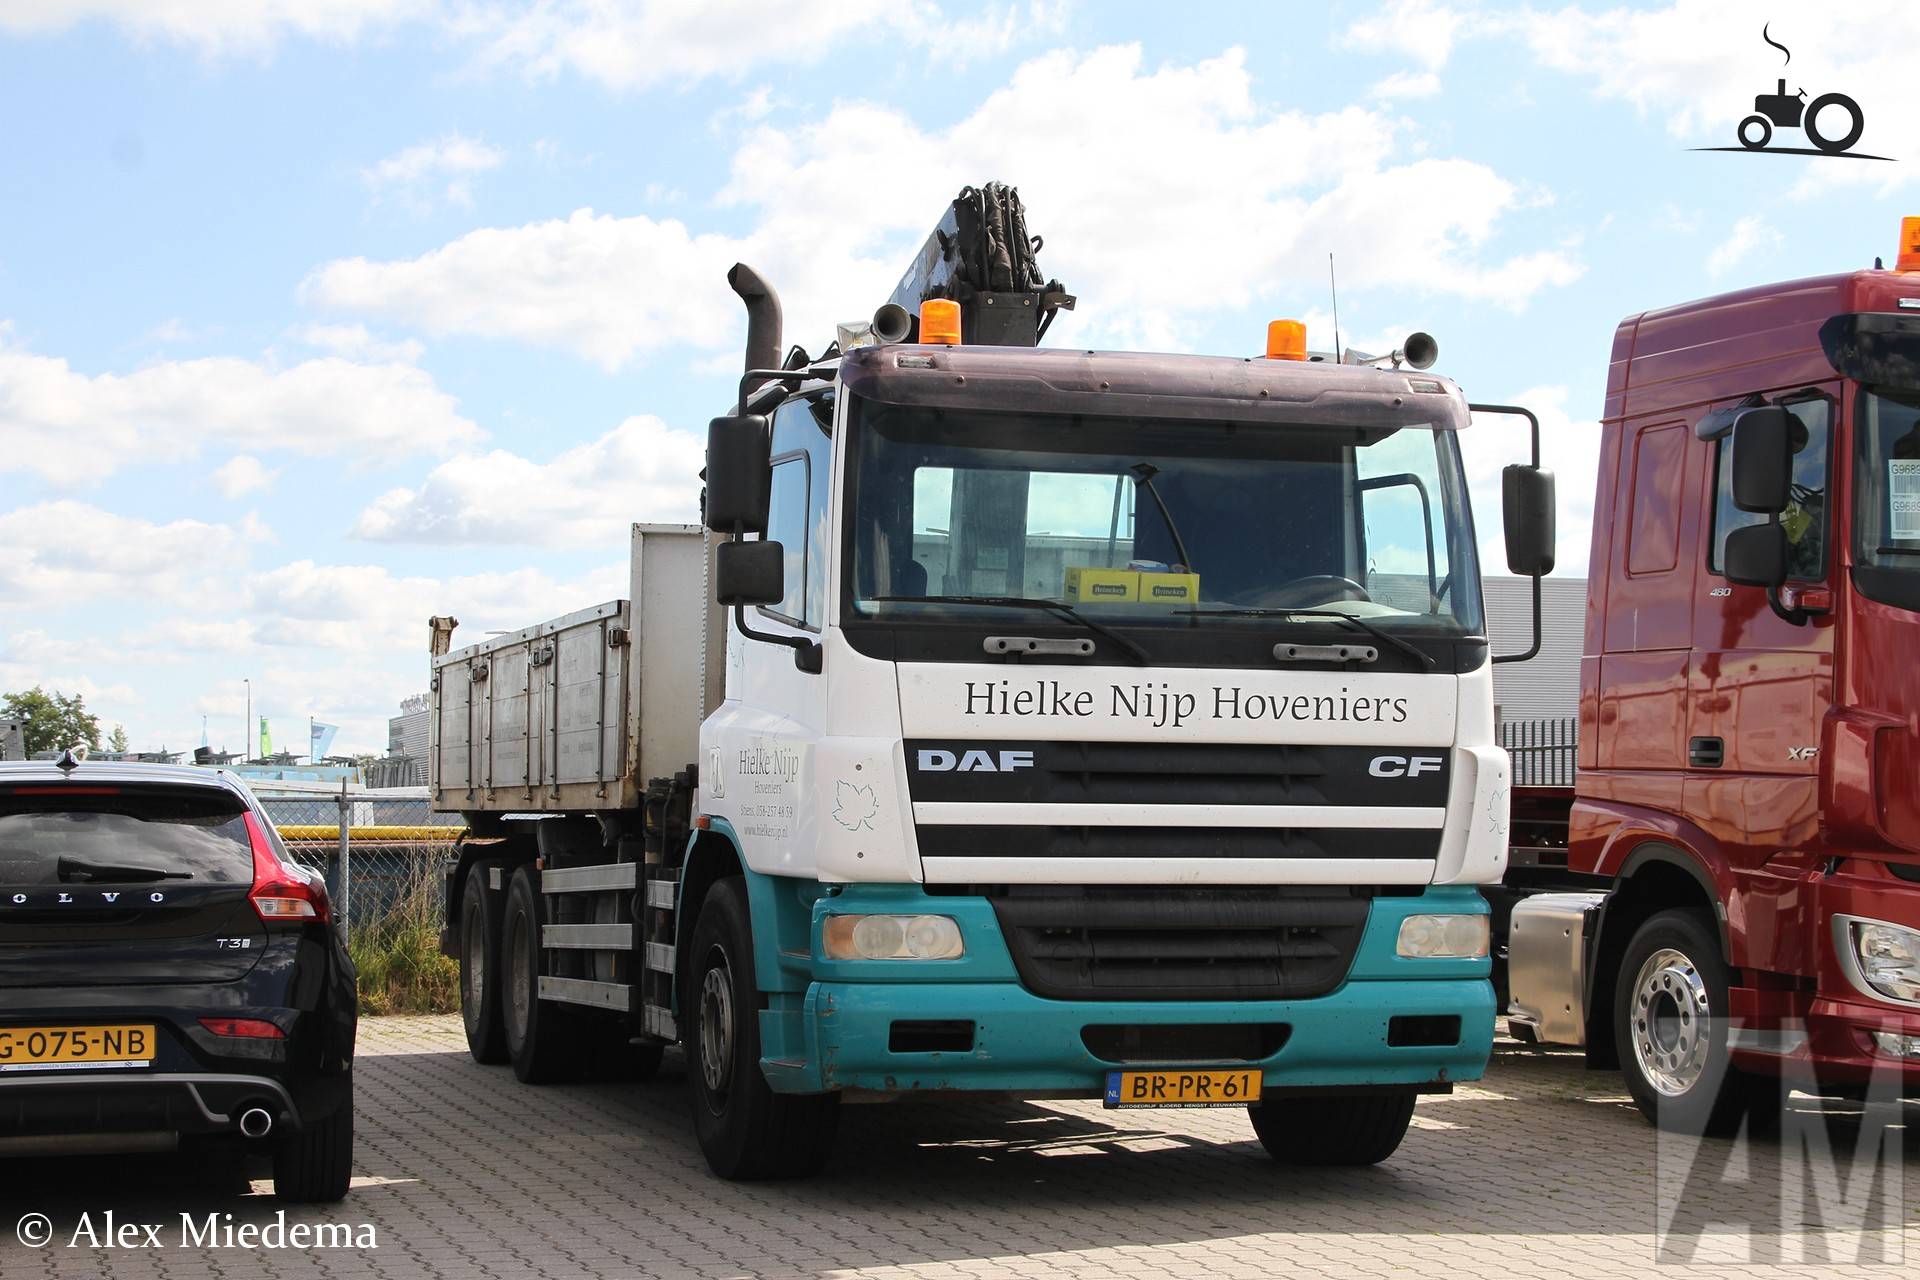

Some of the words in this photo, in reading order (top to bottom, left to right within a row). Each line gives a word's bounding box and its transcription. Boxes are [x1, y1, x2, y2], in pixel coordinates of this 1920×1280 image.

[964, 680, 1094, 717] Hielke
[1110, 682, 1197, 729] Nijp
[1212, 686, 1409, 724] Hoveniers
[739, 748, 771, 775] Hielke
[773, 748, 799, 783] Nijp
[917, 749, 1035, 773] DAF
[1787, 747, 1819, 761] XF
[1367, 755, 1443, 778] CF
[754, 780, 782, 795] Hoveniers
[0, 1030, 145, 1059] G-075-NB
[1108, 1090, 1119, 1098] NL
[1132, 1074, 1249, 1098] BR-PR-61
